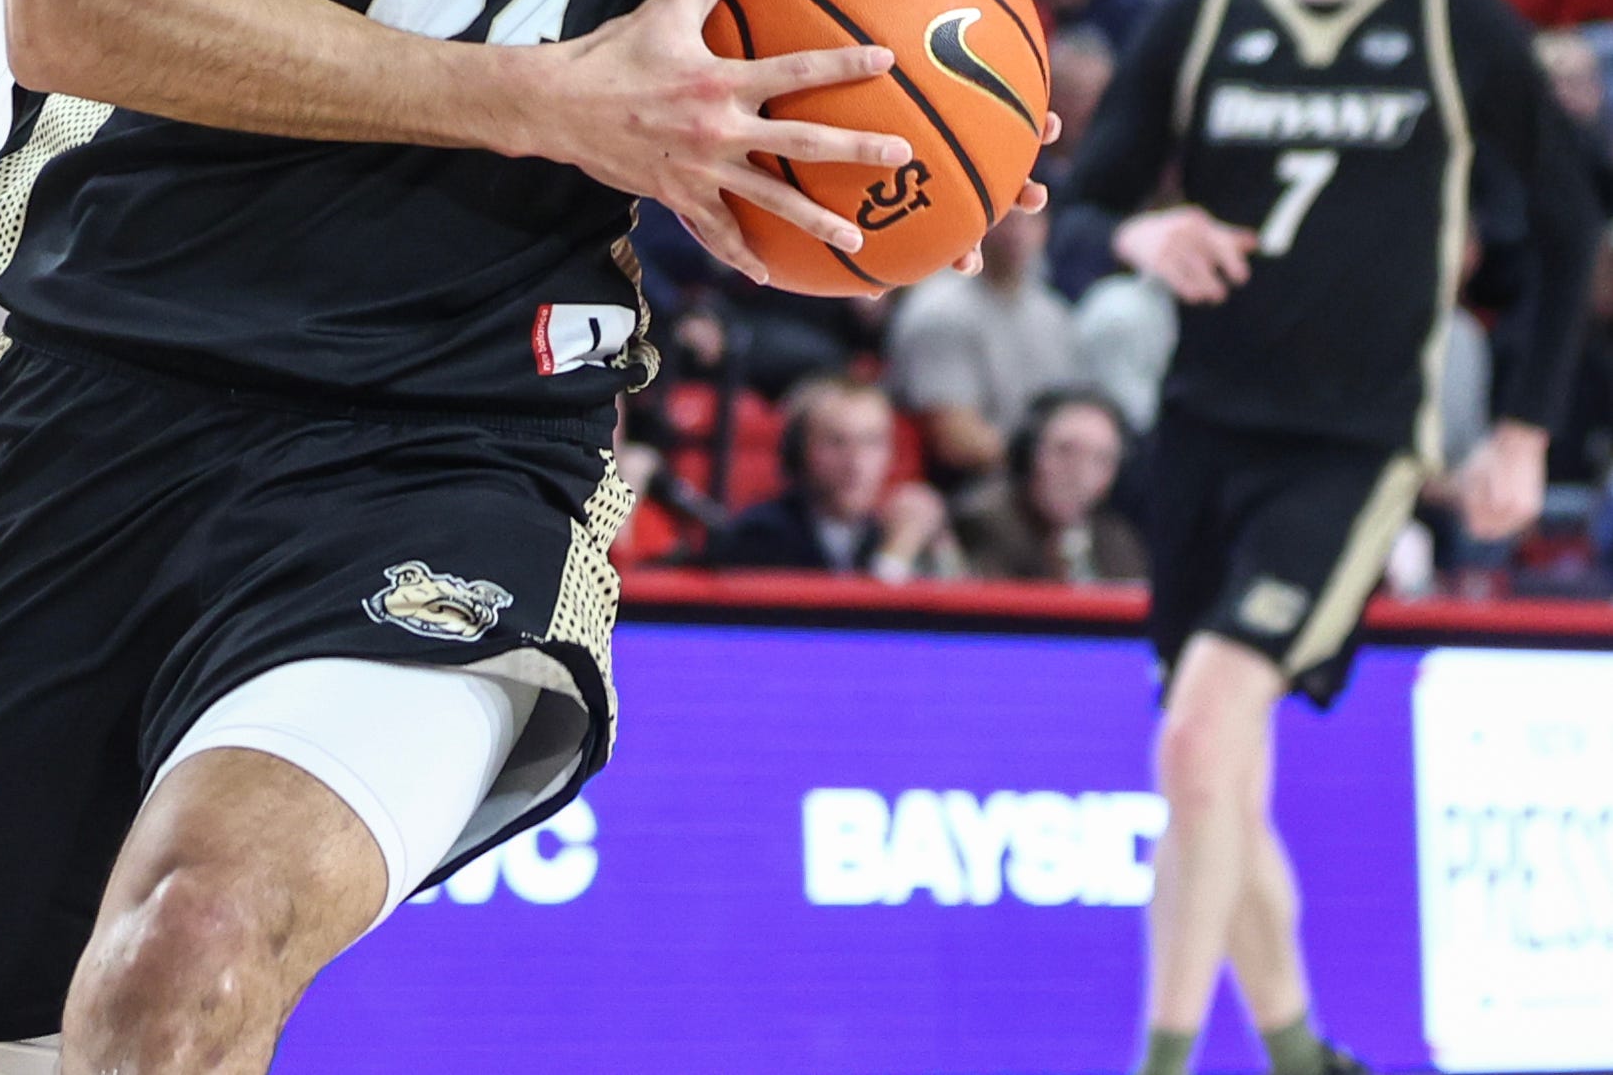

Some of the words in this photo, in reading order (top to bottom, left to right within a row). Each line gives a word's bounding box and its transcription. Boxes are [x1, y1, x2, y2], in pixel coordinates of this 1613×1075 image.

[1206, 82, 1422, 142] BRYANT
[1259, 148, 1340, 258] 7
[802, 787, 1171, 907] BAYSID
